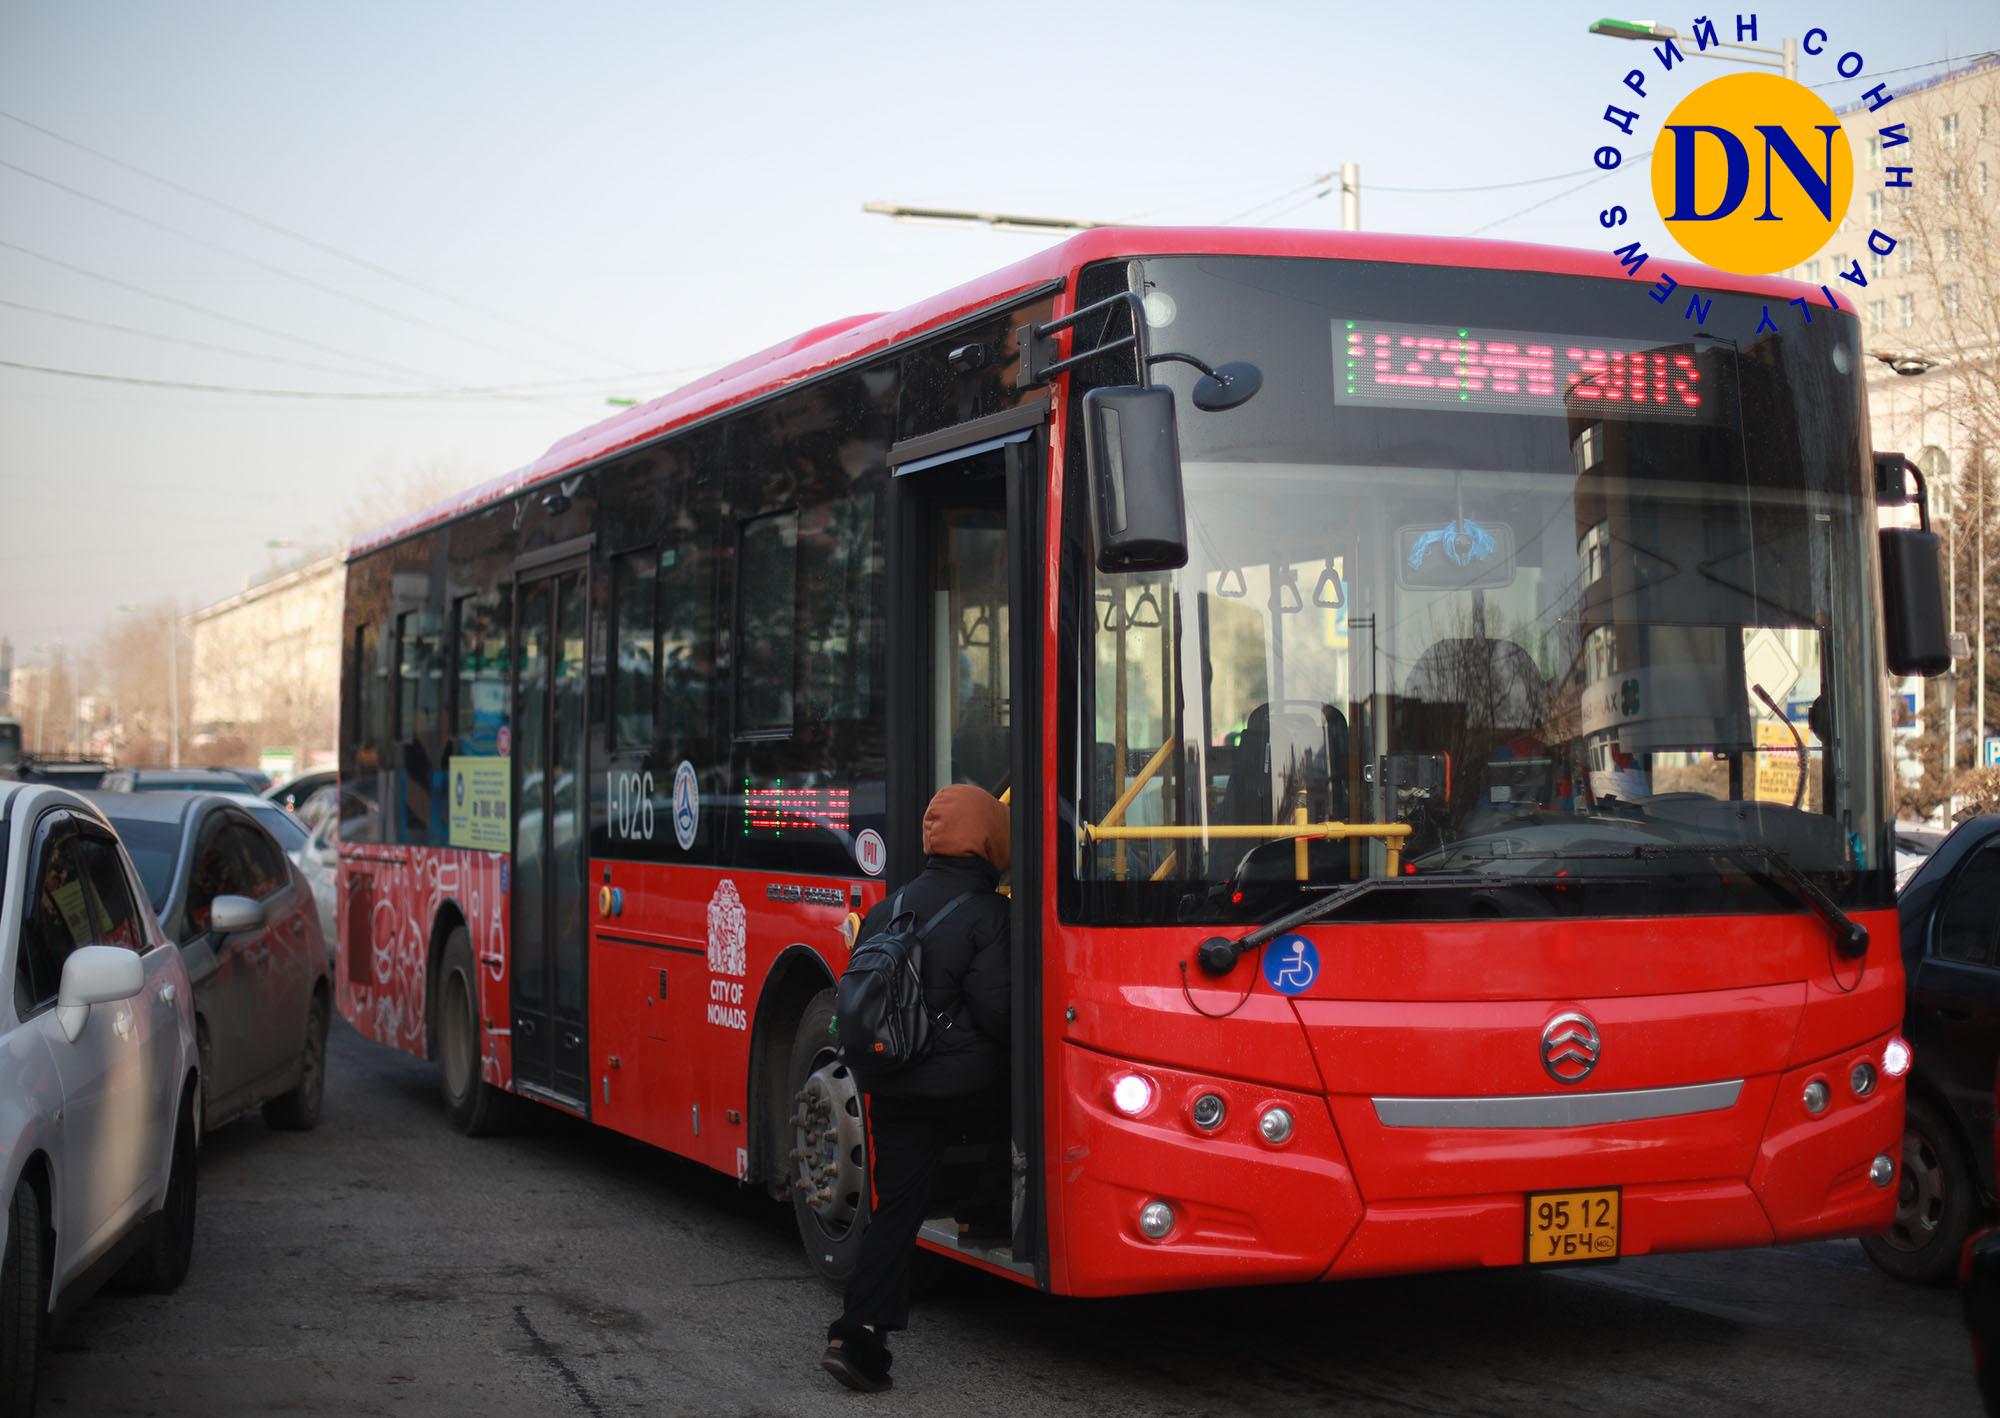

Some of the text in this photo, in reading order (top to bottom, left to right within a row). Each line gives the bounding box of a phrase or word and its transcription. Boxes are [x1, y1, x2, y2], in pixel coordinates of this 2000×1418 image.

[710, 979, 744, 1005] CITY OF
[707, 1003, 747, 1031] NOMADS
[1538, 1198, 1610, 1230] 95 12
